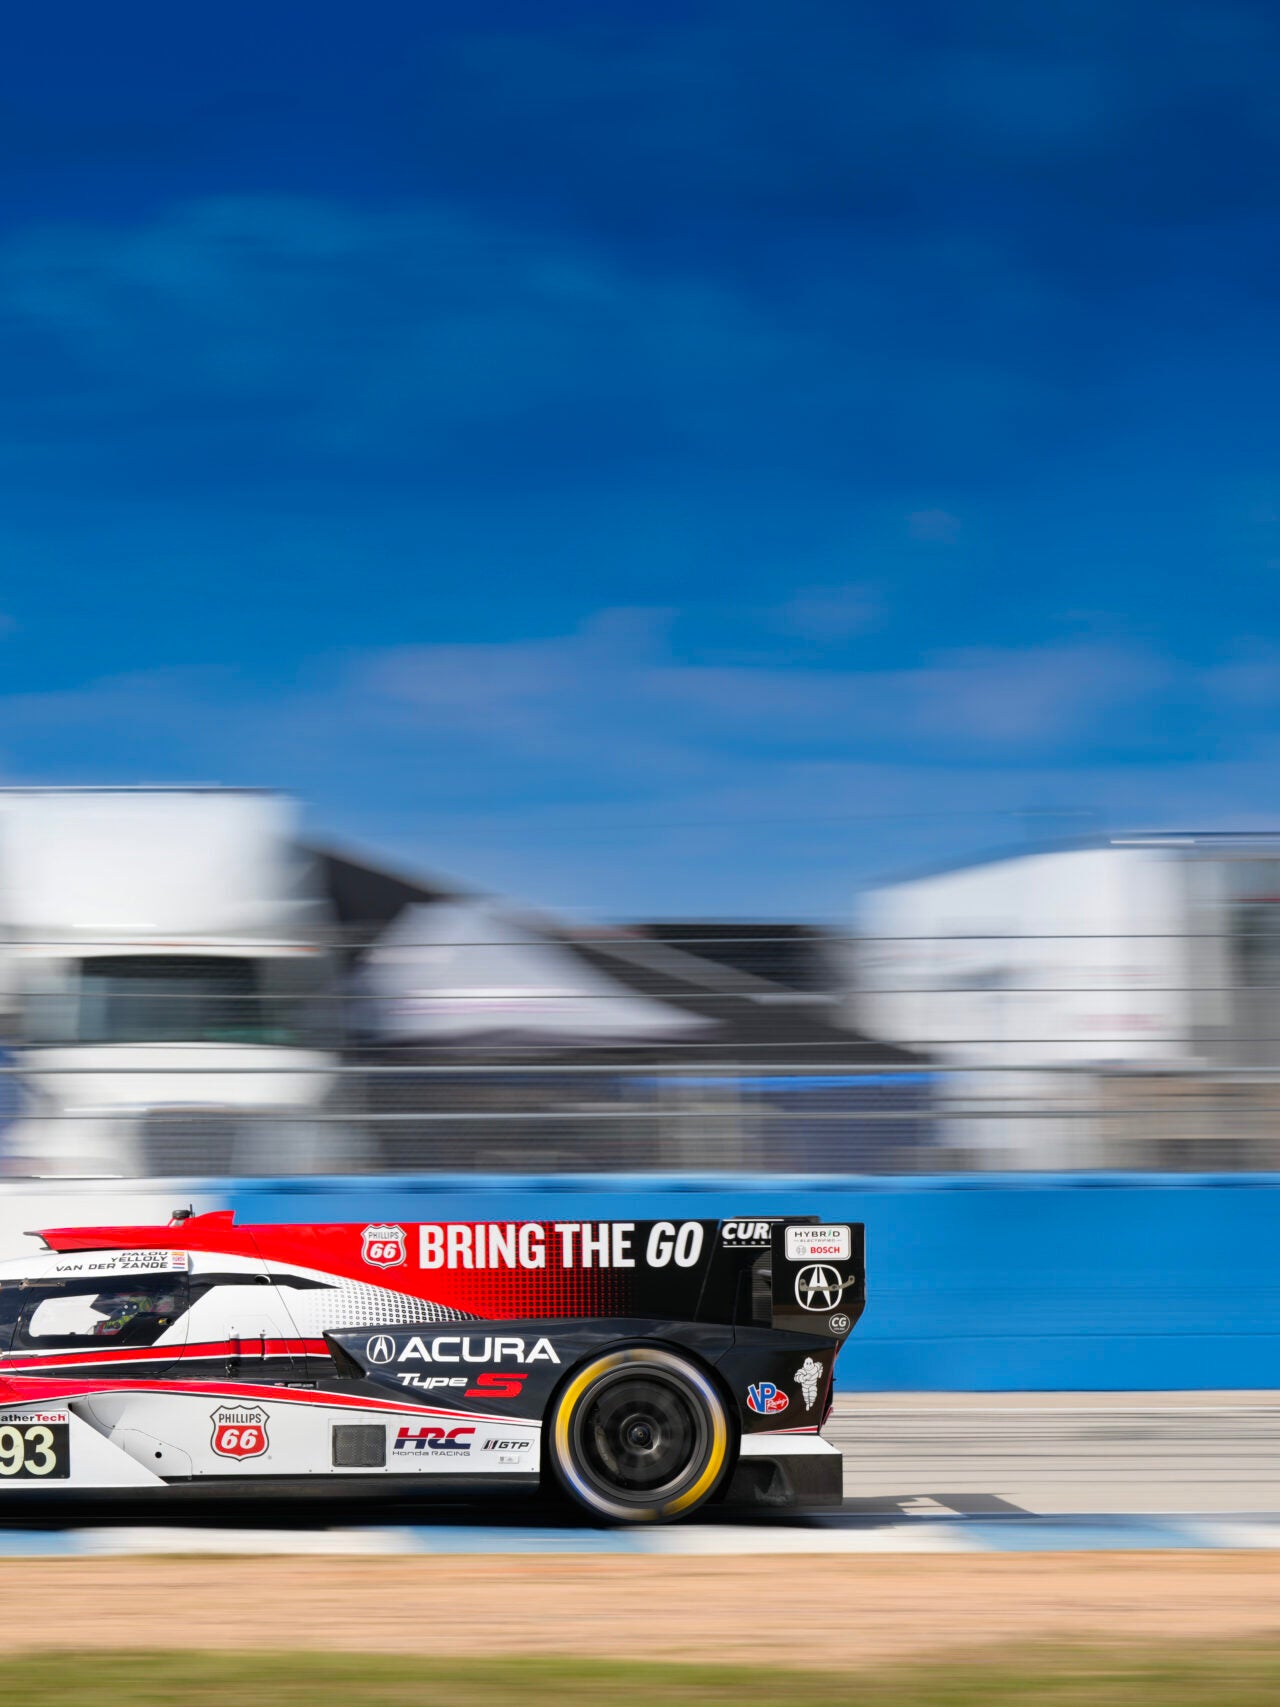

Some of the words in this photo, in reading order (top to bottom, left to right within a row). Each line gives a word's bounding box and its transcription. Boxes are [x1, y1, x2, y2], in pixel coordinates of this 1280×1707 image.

[368, 1231, 399, 1239] PHILLIPS
[722, 1222, 772, 1239] CUR
[794, 1229, 841, 1238] HYBRID
[370, 1243, 397, 1259] 66
[419, 1223, 545, 1269] BRING
[554, 1223, 636, 1268] THE
[646, 1221, 704, 1268] GO
[810, 1246, 840, 1254] BOSCH
[121, 1261, 168, 1269] ZANDE
[831, 1317, 847, 1327] CG
[397, 1336, 561, 1364] ACURA
[397, 1373, 469, 1389] Type
[464, 1373, 528, 1397] S
[747, 1382, 777, 1413] VP
[218, 1413, 262, 1423] PHILLIPS
[221, 1428, 258, 1450] 66
[394, 1427, 476, 1449] HRC
[498, 1441, 530, 1449] GTP
